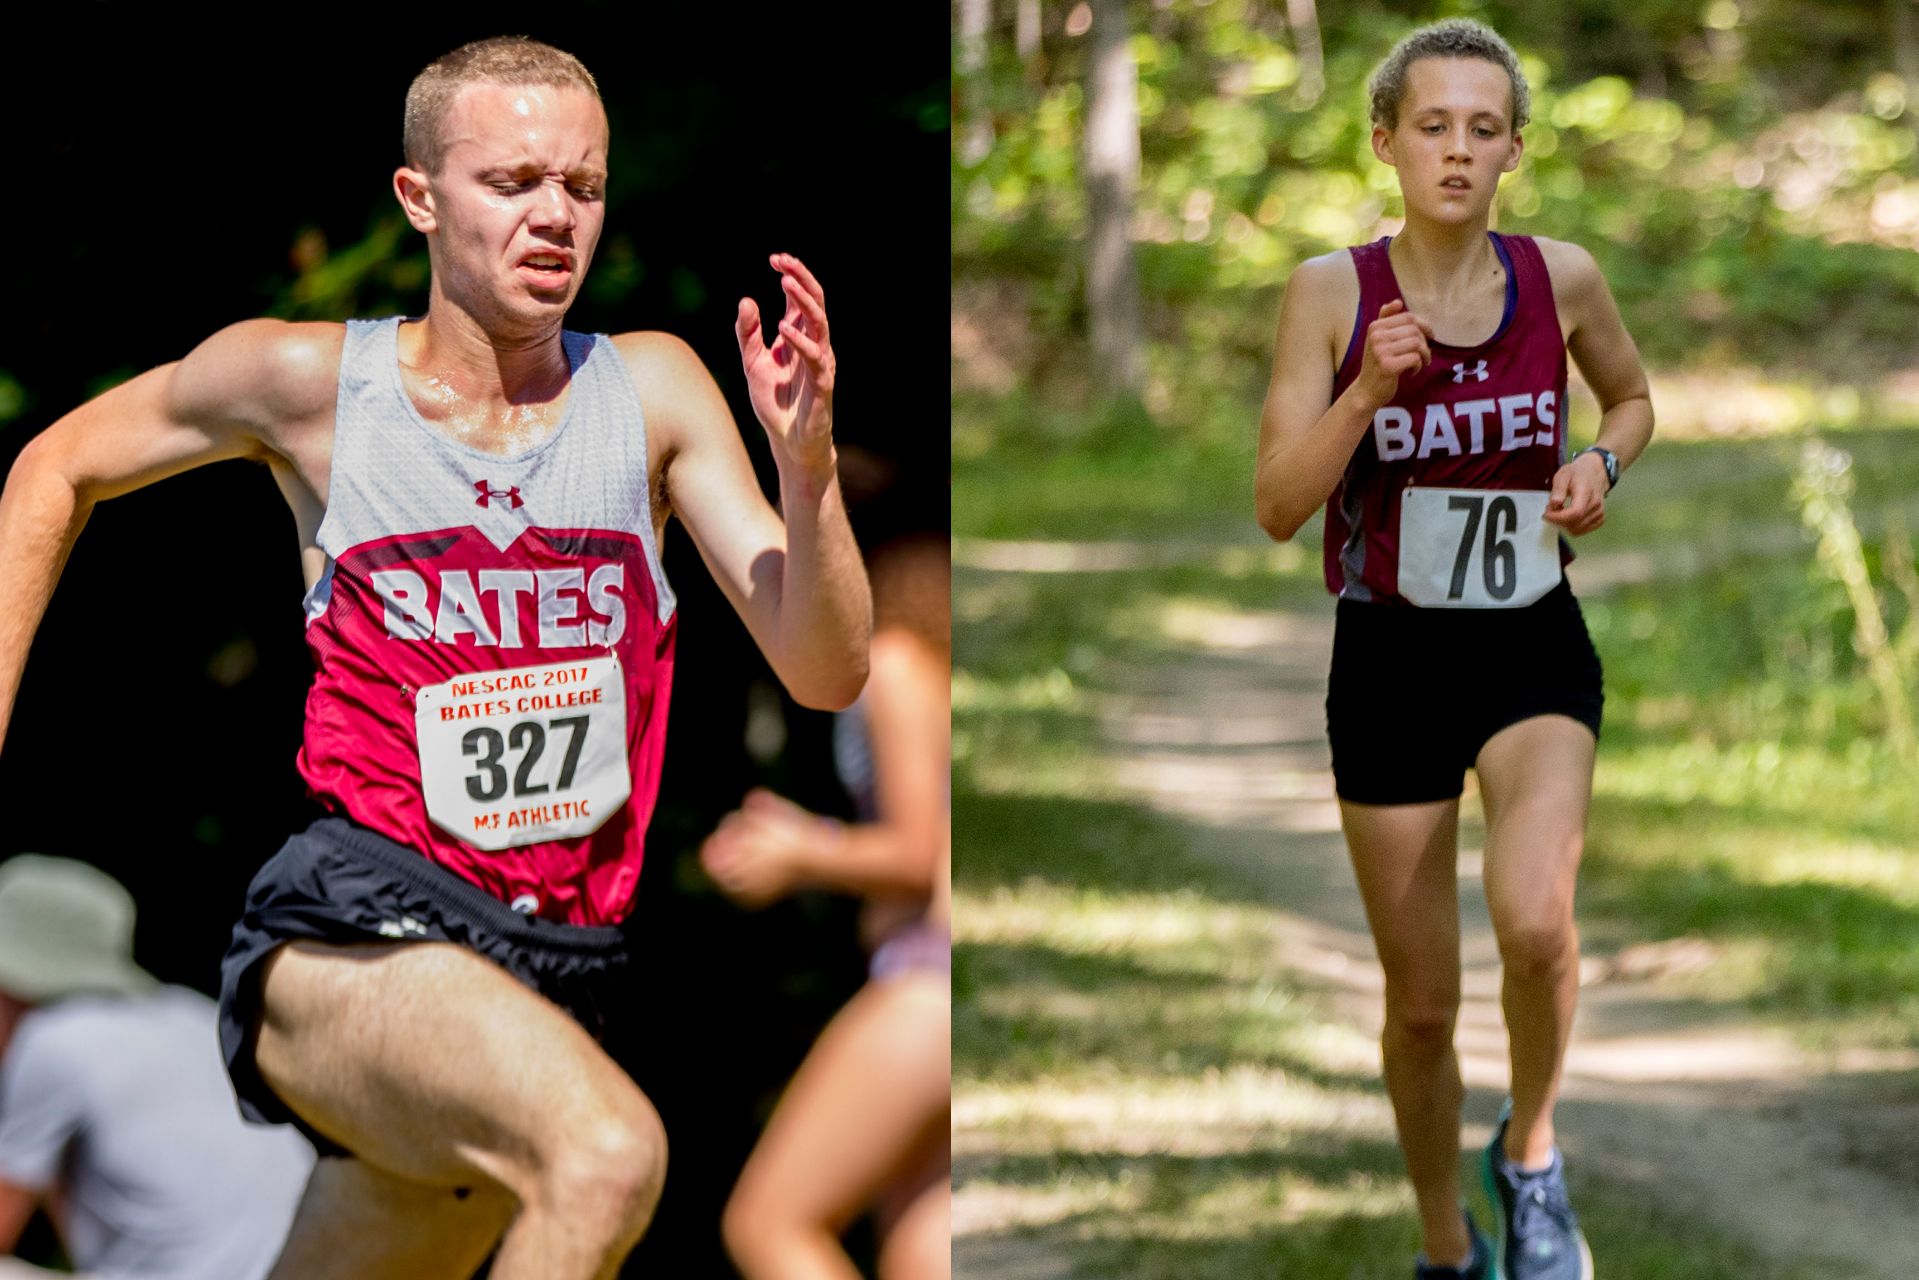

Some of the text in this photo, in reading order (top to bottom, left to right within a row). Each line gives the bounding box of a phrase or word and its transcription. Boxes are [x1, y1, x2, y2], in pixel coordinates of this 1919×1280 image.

[1373, 390, 1556, 462] BATES
[1447, 495, 1518, 601] 76
[370, 564, 626, 649] BATES
[440, 688, 603, 721] BATES COLLEGE
[451, 667, 588, 697] NESCAC 2017
[461, 715, 590, 803] 327
[507, 800, 590, 828] ATHLETIC
